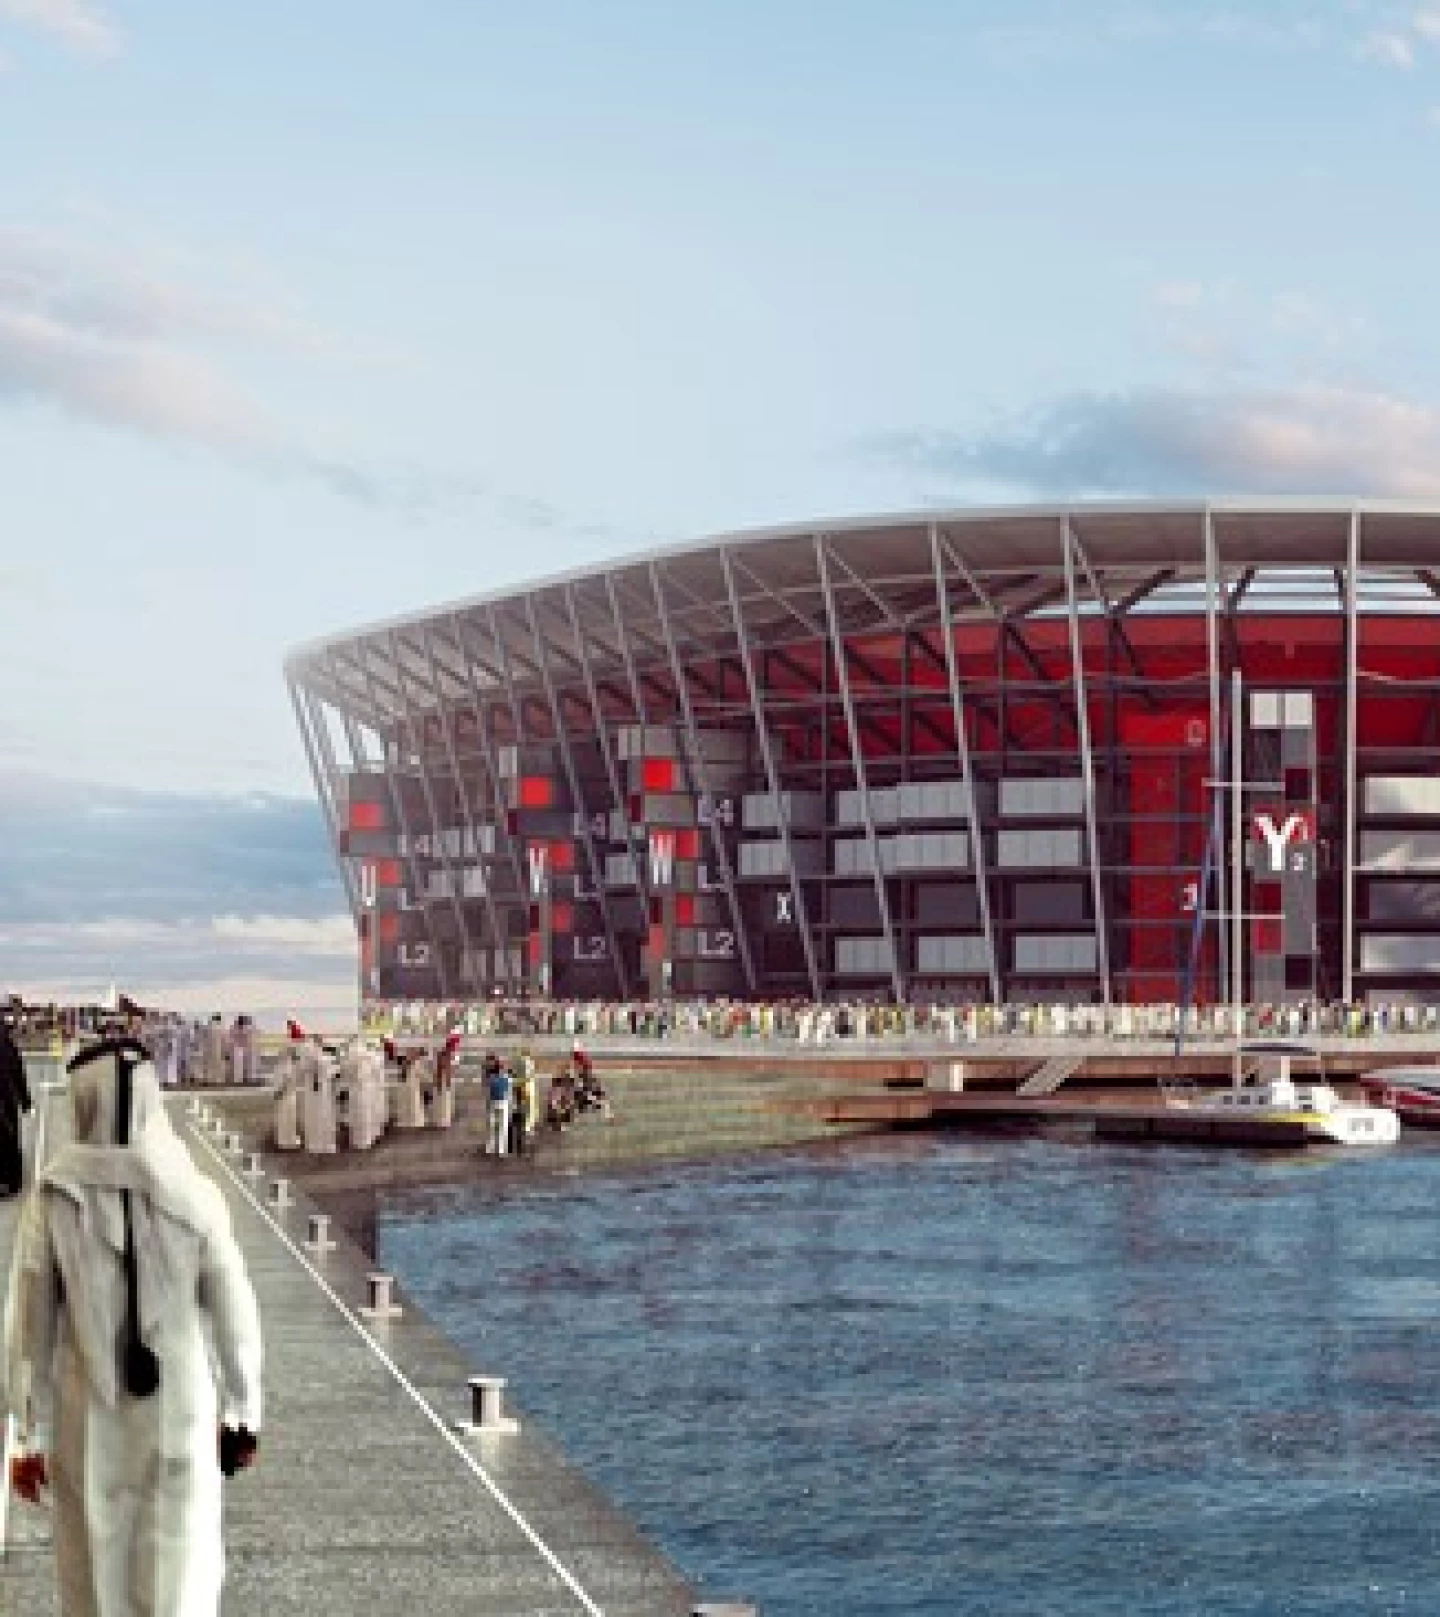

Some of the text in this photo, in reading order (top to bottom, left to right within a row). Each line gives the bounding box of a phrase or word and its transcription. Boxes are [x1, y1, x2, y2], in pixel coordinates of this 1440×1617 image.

[397, 941, 430, 965] L2
[573, 935, 606, 959] L2
[697, 930, 734, 955] L2
